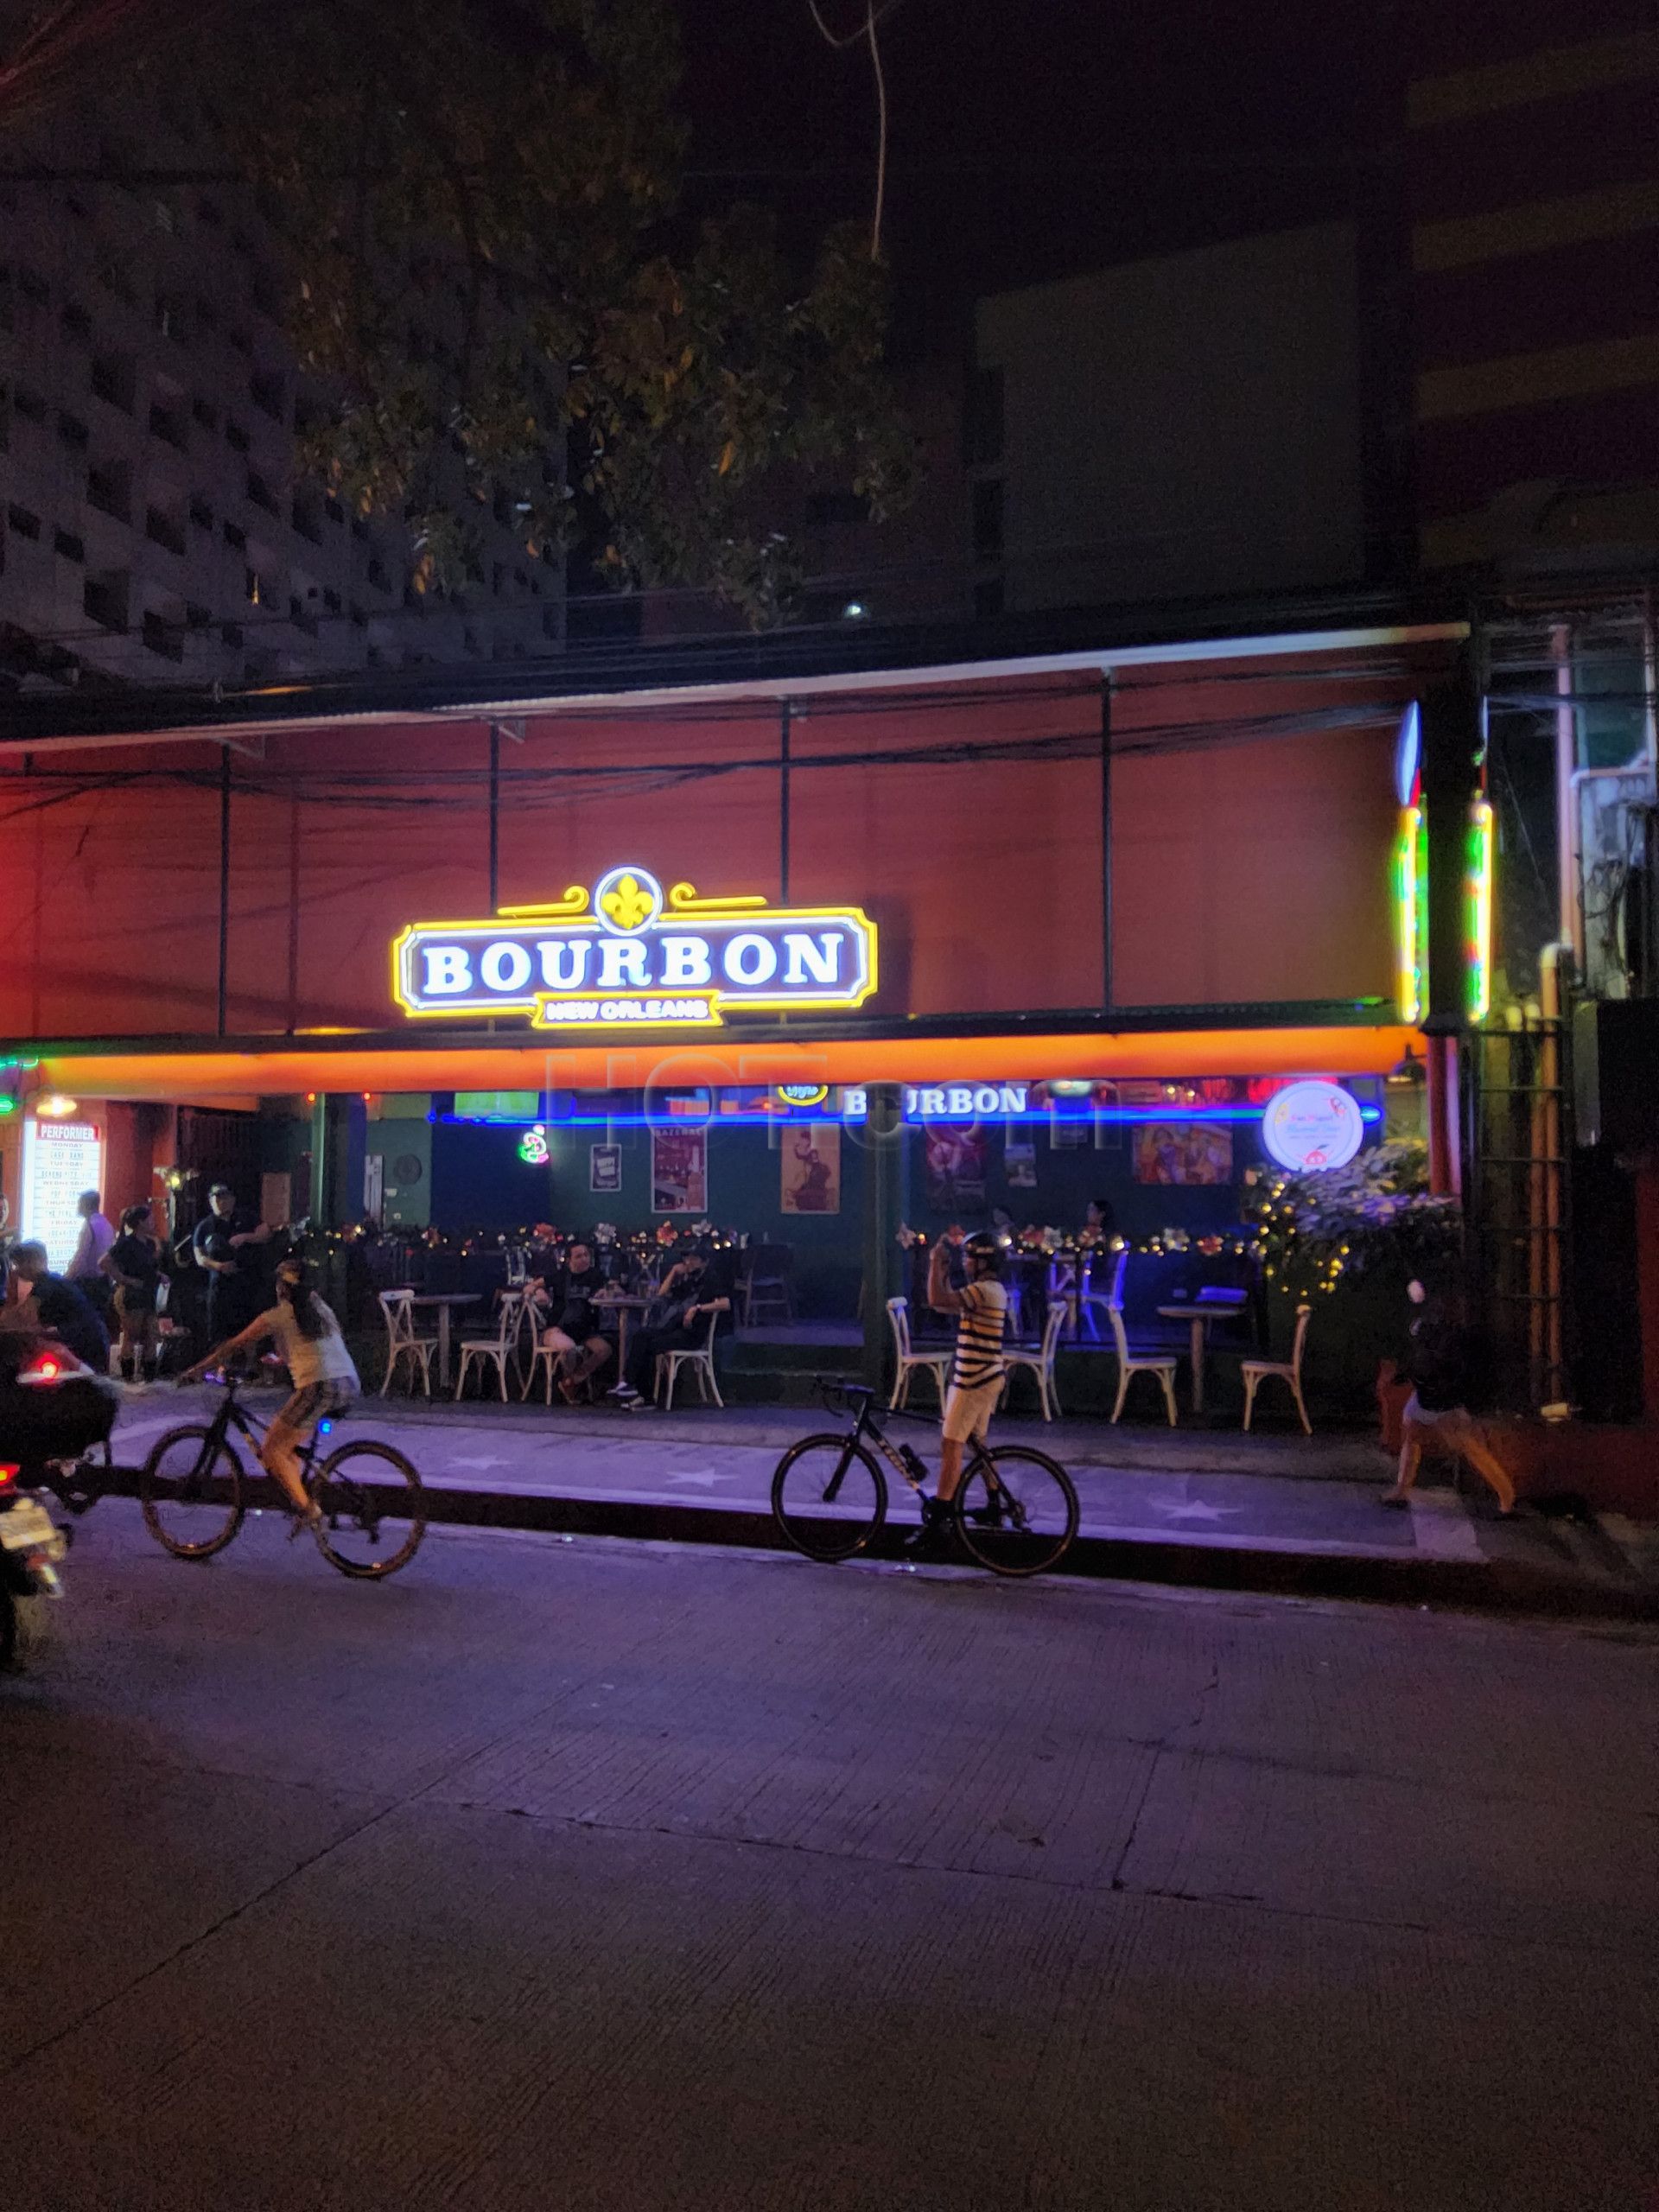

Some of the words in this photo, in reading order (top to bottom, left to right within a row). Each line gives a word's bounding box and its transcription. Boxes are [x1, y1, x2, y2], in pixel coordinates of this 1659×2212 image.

[422, 933, 844, 994] BOURBON
[546, 1001, 600, 1020] NEW
[600, 1000, 709, 1020] ORLEANS
[844, 1088, 1027, 1115] BRBON
